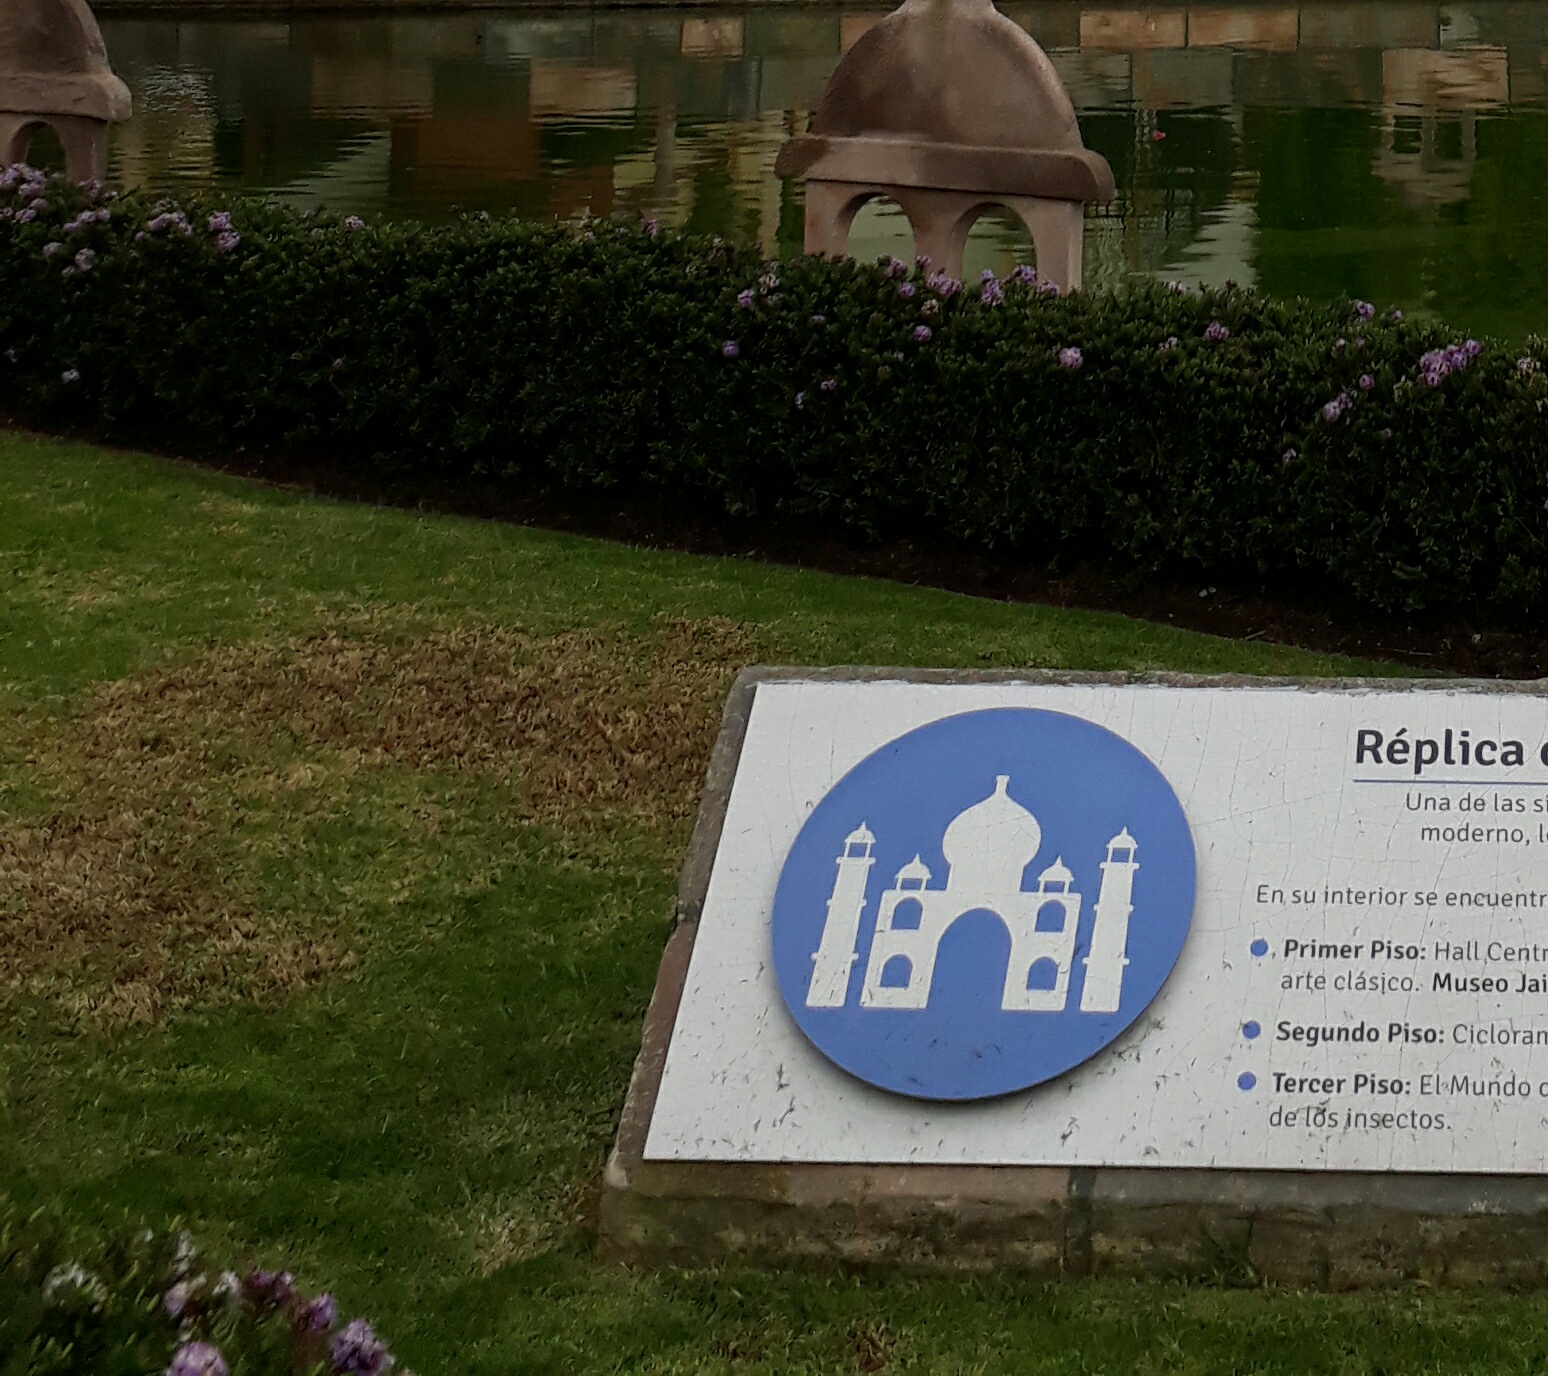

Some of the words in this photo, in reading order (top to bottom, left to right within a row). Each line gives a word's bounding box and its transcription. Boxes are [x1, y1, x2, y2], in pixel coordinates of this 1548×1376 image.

[1355, 727, 1525, 774] Réplica
[1405, 793, 1451, 812] Una
[1458, 793, 1486, 812] de
[1494, 793, 1526, 813] las
[1421, 824, 1530, 846] moderno,
[1256, 885, 1284, 904] En
[1291, 890, 1316, 904] su
[1324, 886, 1408, 905] interior
[1414, 891, 1438, 906] se
[1284, 939, 1363, 960] Primer
[1371, 939, 1426, 960] Piso:
[1435, 941, 1481, 961] Hall
[1280, 973, 1326, 991] arte
[1334, 971, 1420, 992] clásico.
[1432, 973, 1508, 993] Museo
[1276, 1021, 1380, 1047] Segundo
[1388, 1023, 1445, 1044] Piso:
[1273, 1072, 1346, 1094] Tercer
[1354, 1073, 1411, 1095] Piso:
[1420, 1074, 1442, 1096] El
[1450, 1075, 1530, 1098] Mundo
[1269, 1107, 1296, 1128] de
[1306, 1107, 1338, 1129] los
[1346, 1109, 1452, 1130] insectos.
